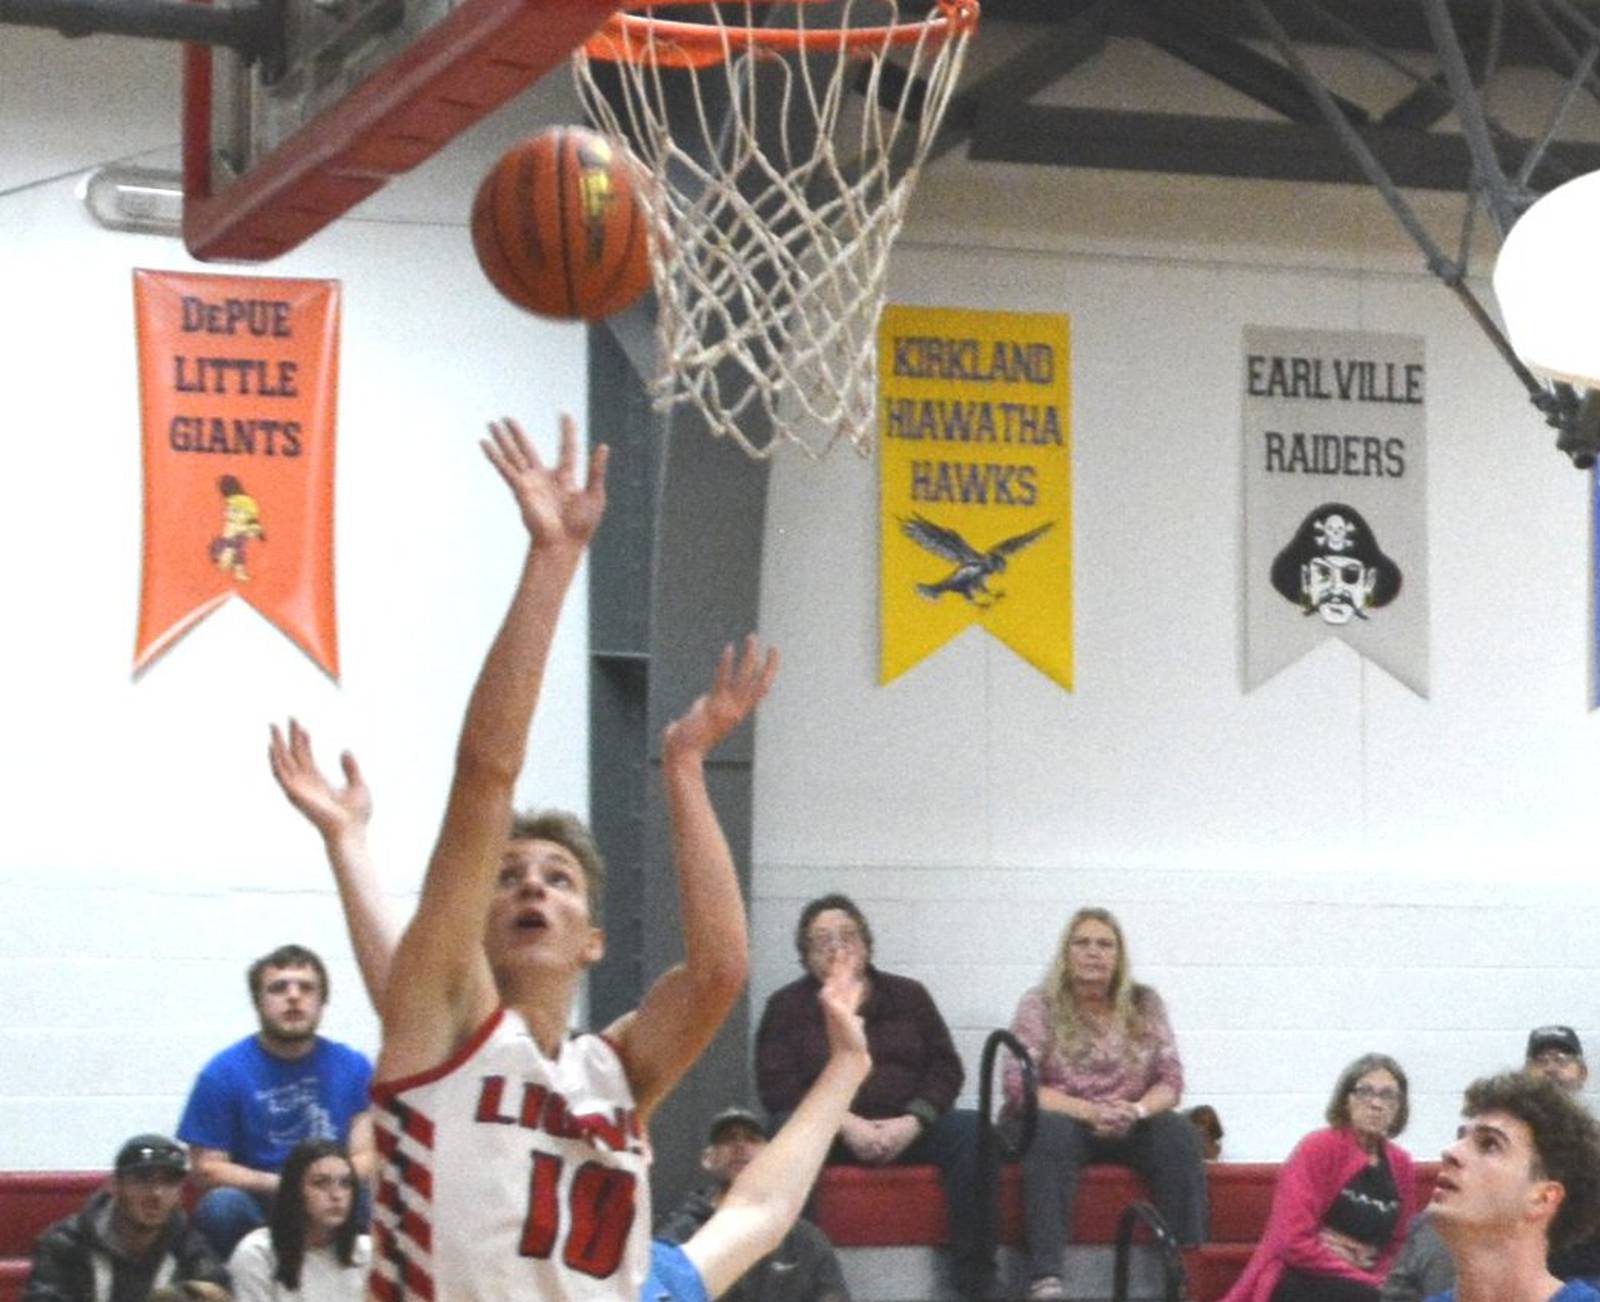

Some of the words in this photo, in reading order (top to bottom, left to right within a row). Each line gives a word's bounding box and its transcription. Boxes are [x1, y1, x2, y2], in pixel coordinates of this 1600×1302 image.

[182, 297, 291, 338] DePUE
[174, 355, 298, 398] LITTLE
[893, 335, 1056, 384] KIRKLAND
[1247, 354, 1425, 405] EARLVILLE
[169, 416, 302, 458] GIANTS
[887, 397, 1064, 446] HIAWATHA
[1265, 431, 1406, 478] RAIDERS
[911, 460, 1038, 507] HAWKS
[517, 1149, 637, 1280] 10
